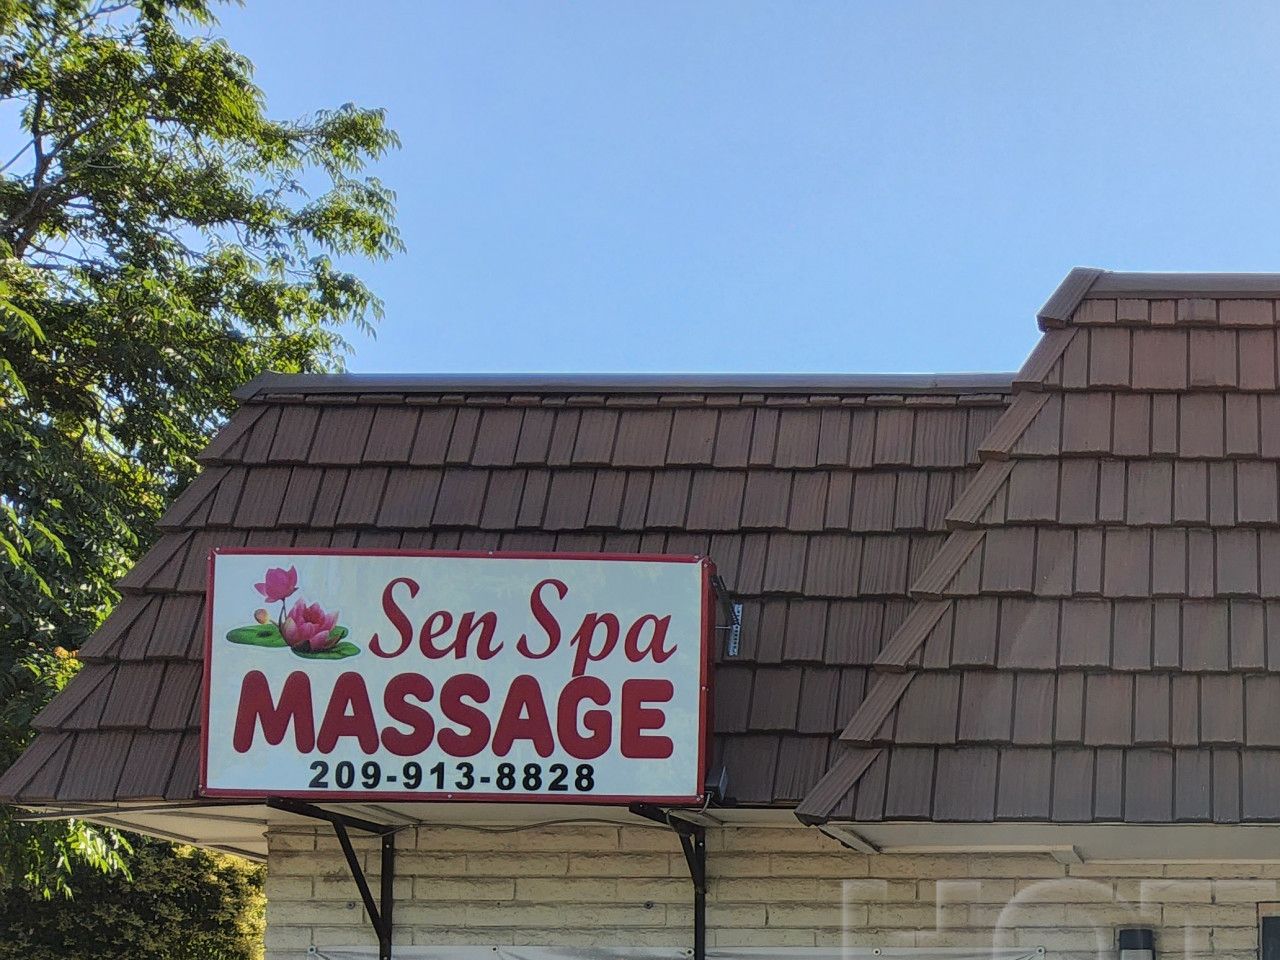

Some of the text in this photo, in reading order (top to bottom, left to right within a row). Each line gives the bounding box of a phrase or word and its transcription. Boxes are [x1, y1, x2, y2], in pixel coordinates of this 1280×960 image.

[368, 577, 678, 677] Sen Spa
[232, 669, 675, 760] MASSAGE
[308, 760, 596, 792] 209-913-8828
